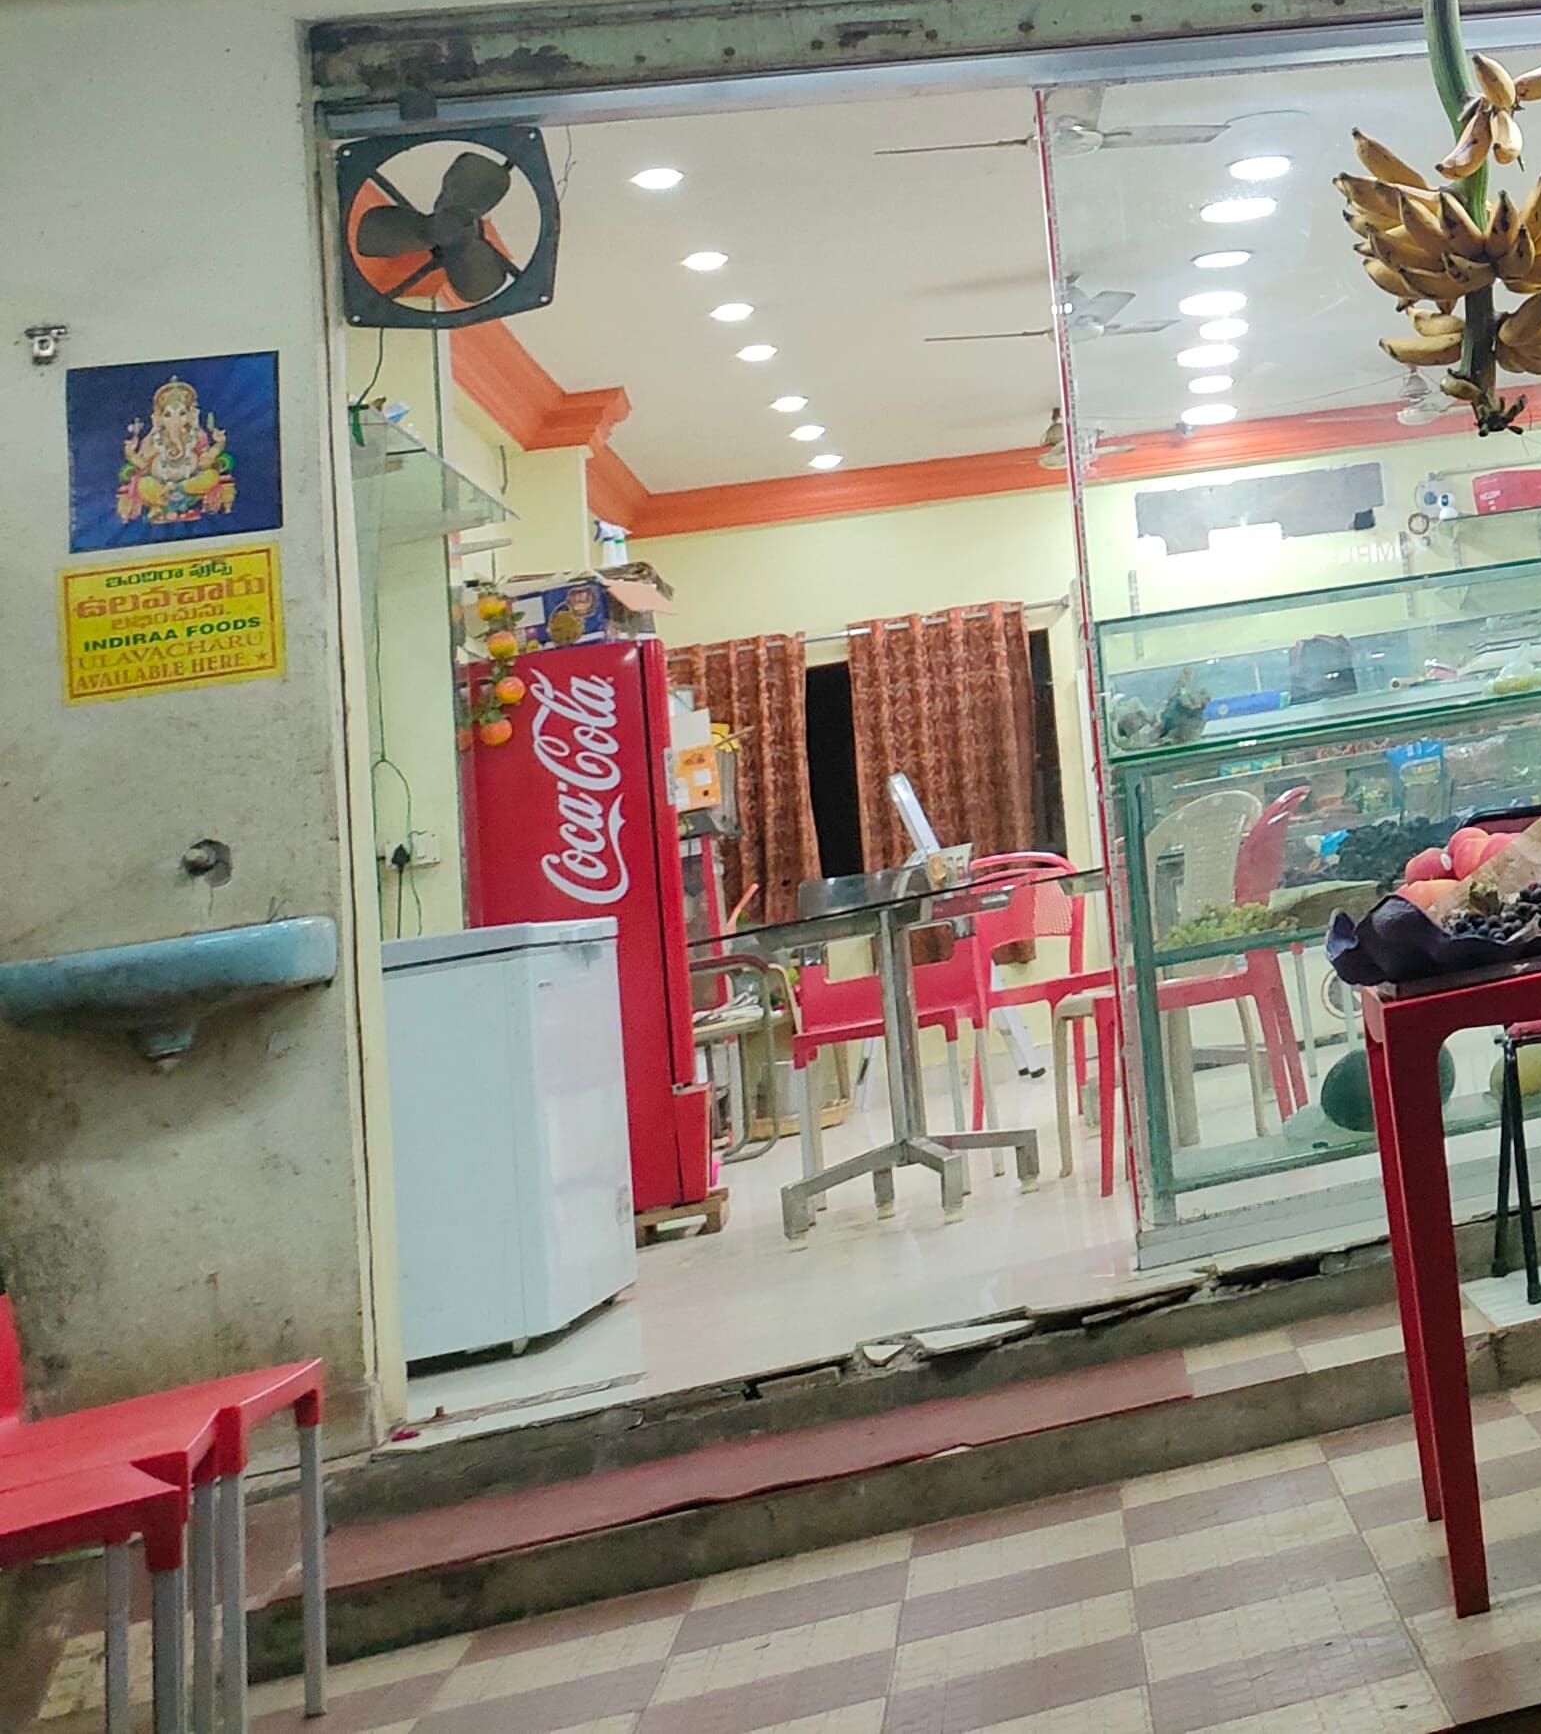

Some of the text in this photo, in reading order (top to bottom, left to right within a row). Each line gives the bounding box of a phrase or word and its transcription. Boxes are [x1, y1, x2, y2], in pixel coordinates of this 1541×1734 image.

[78, 632, 264, 671] ULAVACHARU
[83, 616, 261, 652] INDIRAA FOODS
[76, 661, 185, 692] AVAILABLE
